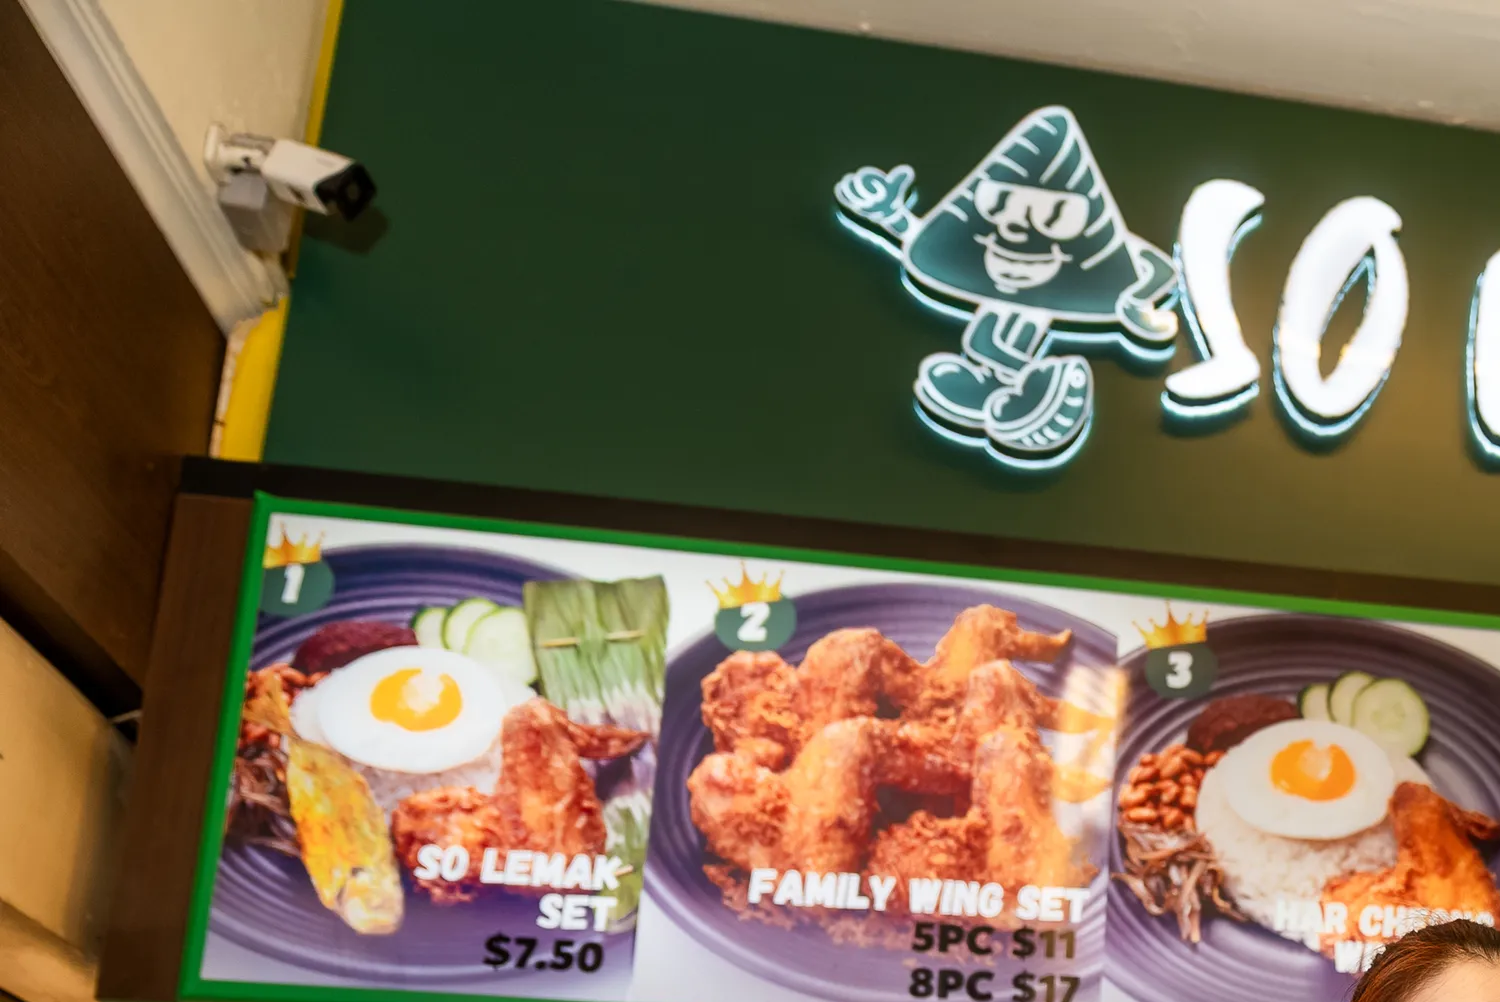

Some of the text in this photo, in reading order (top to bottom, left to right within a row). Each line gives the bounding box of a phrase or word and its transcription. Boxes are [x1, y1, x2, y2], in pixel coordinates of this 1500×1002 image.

[1160, 178, 1409, 437] SO
[281, 563, 305, 604] 1
[737, 602, 770, 642] 2
[1166, 651, 1194, 689] 3
[413, 844, 621, 891] SO LEMAK
[535, 893, 618, 932] SET
[747, 867, 1091, 924] FAMILY WING SET
[1275, 899, 1348, 935] HAR
[483, 935, 603, 973] $7.50
[911, 922, 1076, 962] 5PC $11
[908, 967, 994, 1002] 8PC
